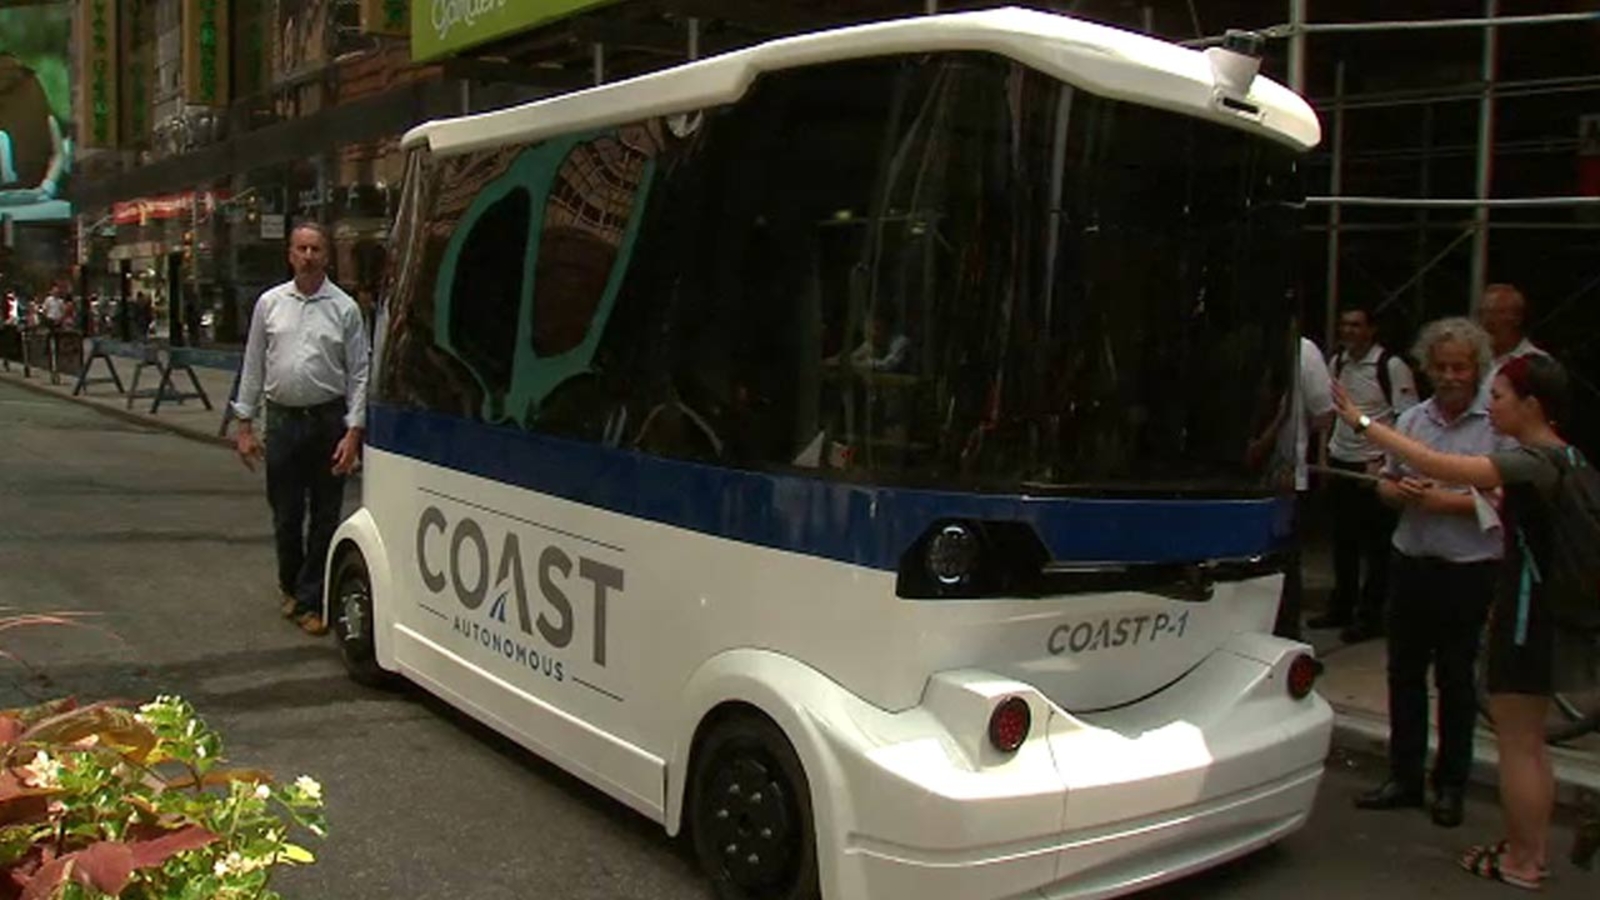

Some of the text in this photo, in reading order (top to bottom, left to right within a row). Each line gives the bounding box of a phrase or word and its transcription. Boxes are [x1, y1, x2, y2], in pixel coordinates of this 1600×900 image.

[417, 505, 624, 668] COAST
[453, 617, 564, 681] AUTONOMOUS
[1047, 610, 1189, 655] COAST P-1
